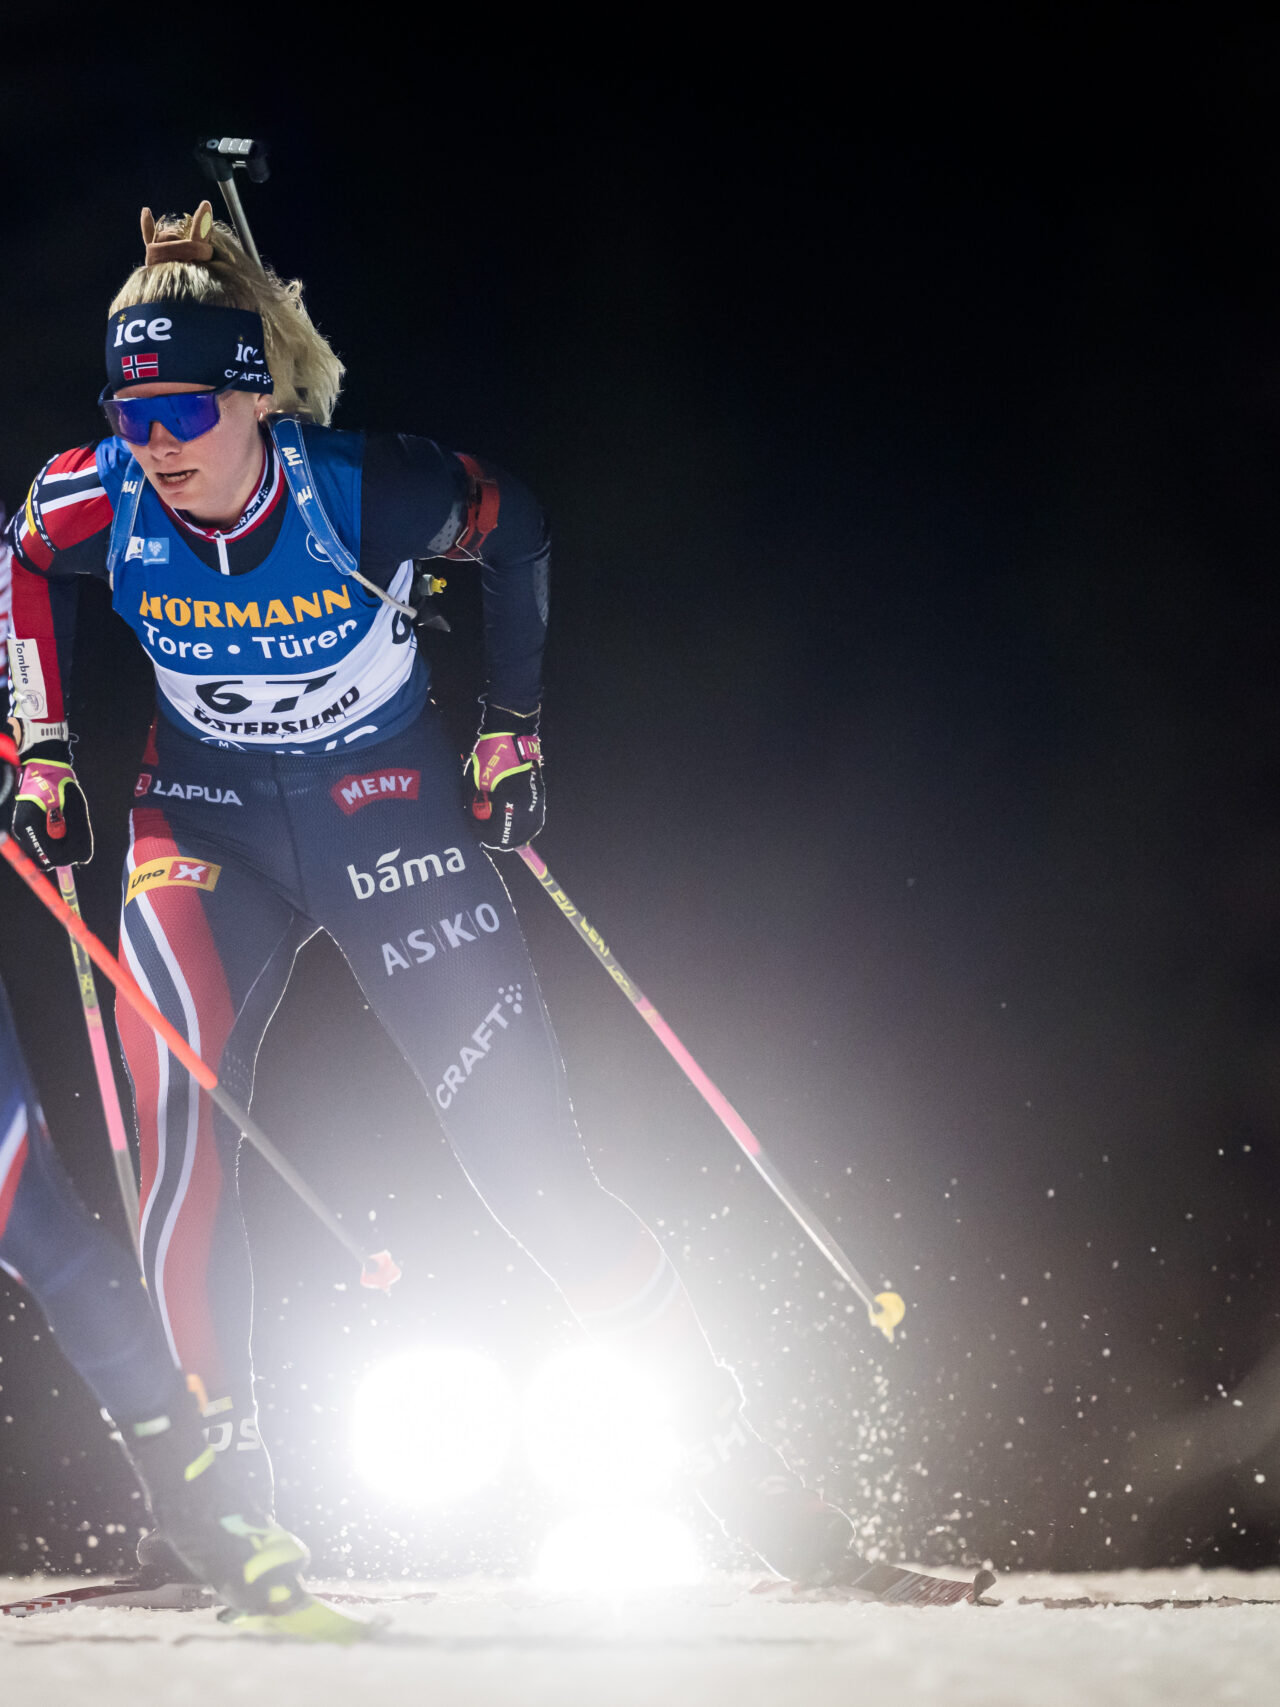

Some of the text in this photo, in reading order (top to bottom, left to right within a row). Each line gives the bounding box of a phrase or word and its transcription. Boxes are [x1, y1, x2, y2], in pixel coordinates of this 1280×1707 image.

[114, 313, 173, 348] ice
[139, 584, 351, 628] HÖRMANN
[142, 620, 214, 659] Tore
[15, 641, 30, 685] Tombre
[193, 685, 361, 737] ÖSTERSUND
[196, 671, 337, 715] 67
[153, 780, 243, 806] LAPUA
[341, 774, 413, 805] MENY
[435, 1003, 509, 1110] CRAFT
